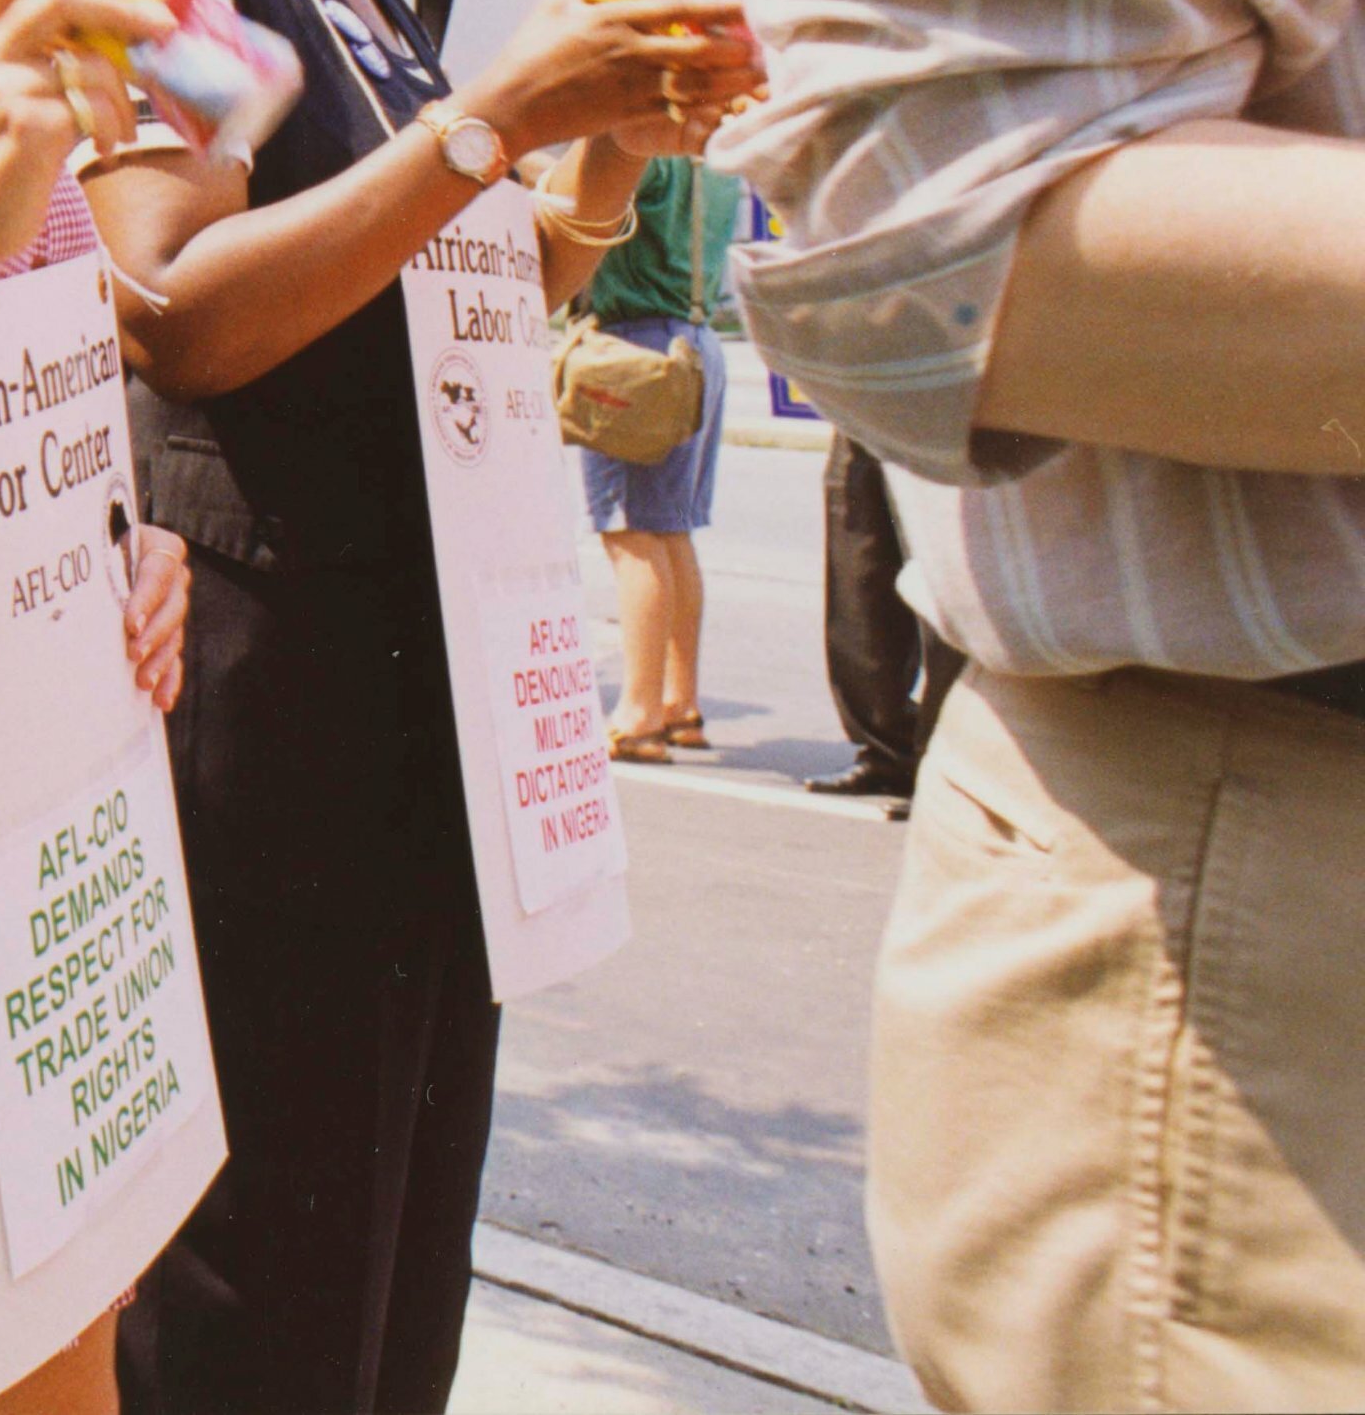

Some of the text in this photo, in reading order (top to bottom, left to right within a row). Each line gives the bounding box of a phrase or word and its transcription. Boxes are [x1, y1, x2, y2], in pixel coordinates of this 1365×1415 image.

[448, 289, 513, 344] Labor
[40, 422, 113, 498] Center
[12, 543, 92, 618] AFL-CIO
[38, 789, 129, 889] AFL-CIO
[29, 837, 144, 957] DEMANDS
[5, 876, 169, 1040] RESPECT FOR
[16, 931, 175, 1097] TRADE UNION
[70, 1017, 156, 1127] RIGHTS
[56, 1059, 181, 1207] IN NIGERIA
